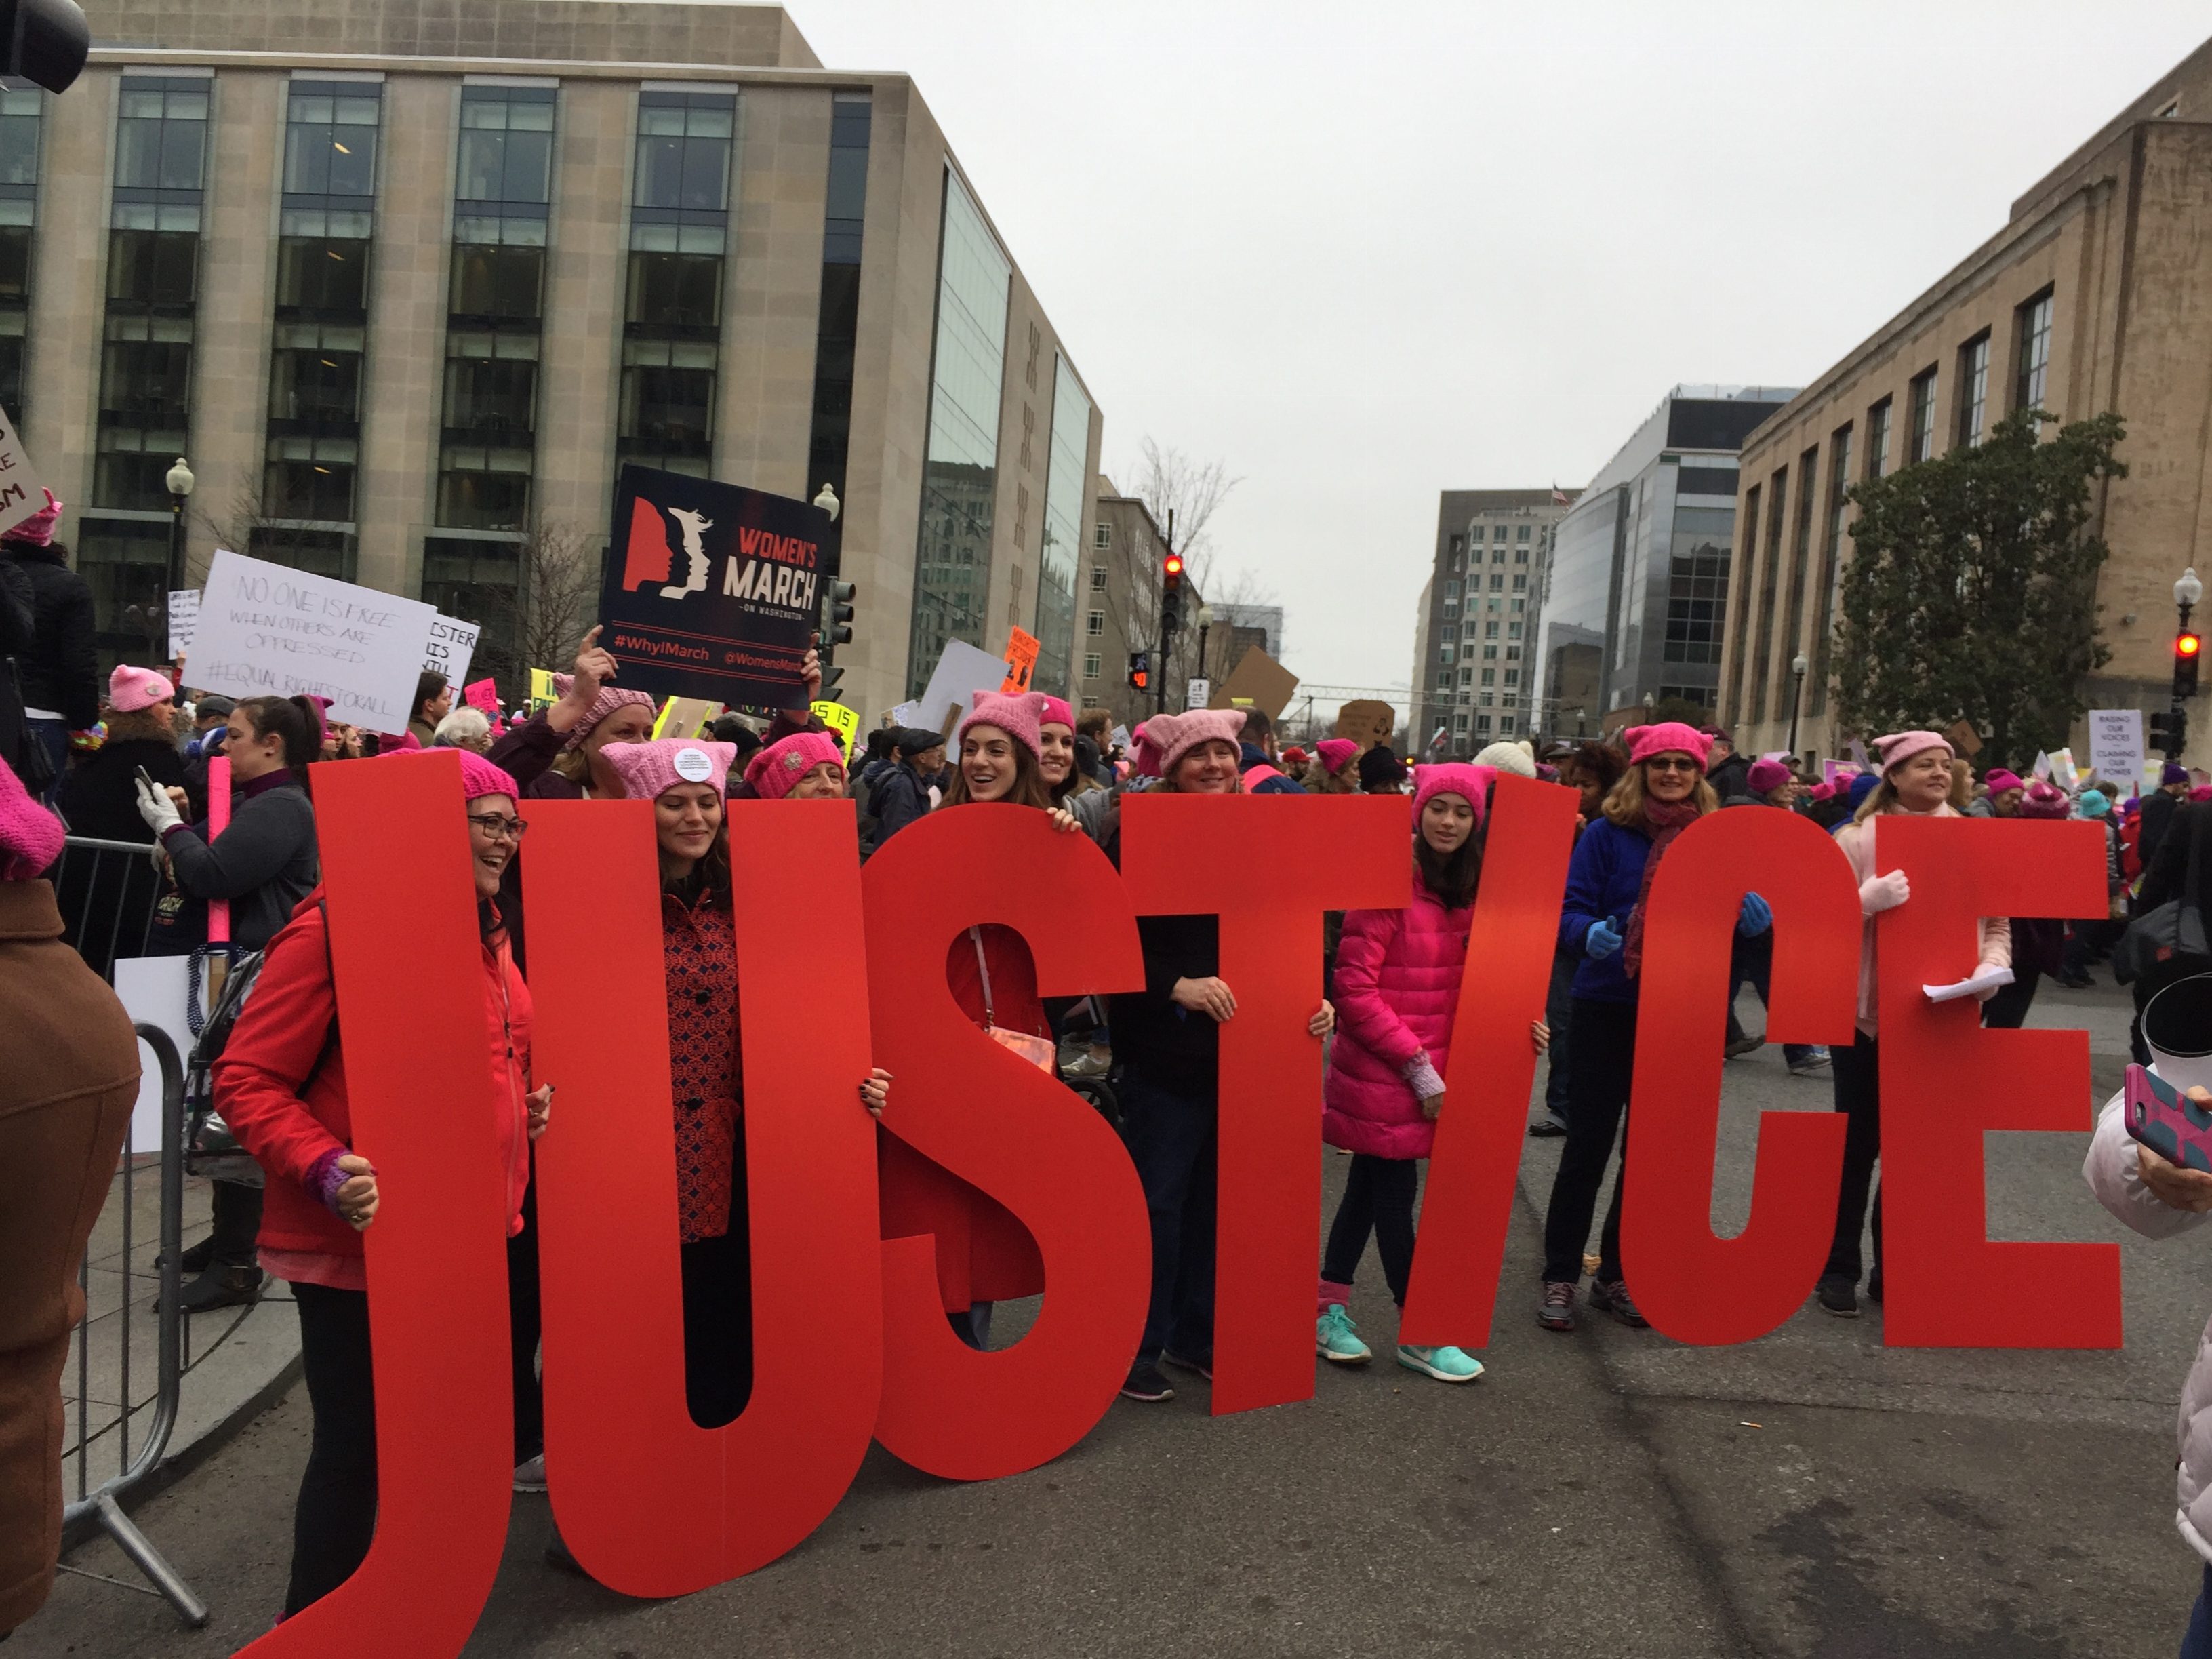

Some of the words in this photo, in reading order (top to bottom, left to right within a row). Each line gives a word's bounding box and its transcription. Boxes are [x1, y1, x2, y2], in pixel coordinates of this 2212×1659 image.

[739, 526, 818, 568] WOMEN'S
[722, 555, 818, 611] MARCH
[237, 576, 269, 603] NO
[274, 582, 317, 612] ONE
[322, 597, 342, 618] IS
[344, 603, 401, 628] FREE
[230, 609, 277, 627] WHEN
[279, 616, 335, 637] OTHERS
[340, 628, 375, 645] ARE
[245, 633, 365, 664] OPPRESSED
[614, 635, 710, 660] #WhyIMarch
[2096, 750, 2137, 758] CLAIMING
[2101, 734, 2130, 742] VOICES
[230, 748, 2124, 1659] JUSTICE
